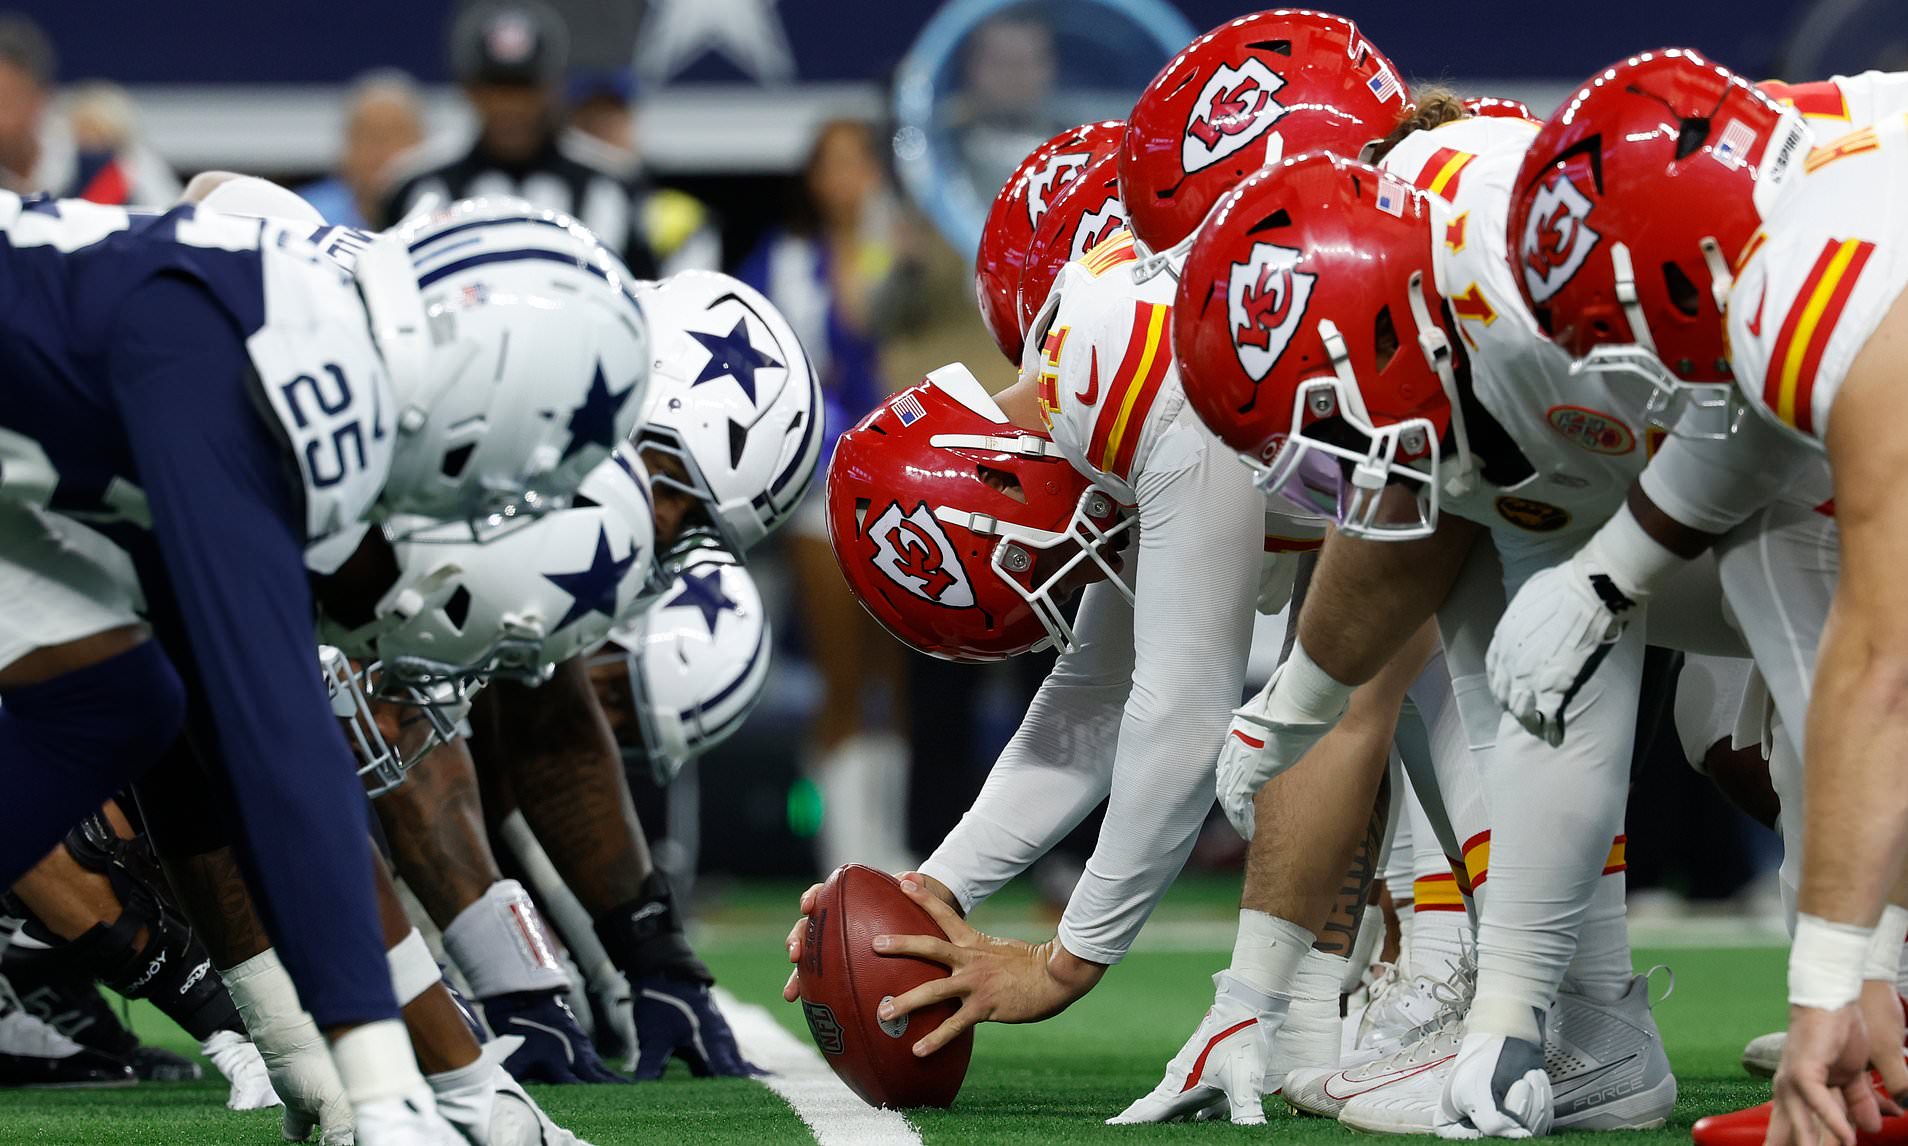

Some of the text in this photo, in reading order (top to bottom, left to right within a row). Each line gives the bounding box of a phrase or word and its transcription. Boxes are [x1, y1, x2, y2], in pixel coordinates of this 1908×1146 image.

[1187, 75, 1270, 153] KC
[1527, 199, 1579, 284] KC
[1237, 262, 1294, 352] KC
[281, 363, 366, 489] 25
[884, 517, 959, 603] KC
[812, 1008, 840, 1050] NFL
[1573, 1075, 1644, 1111] FORCE
